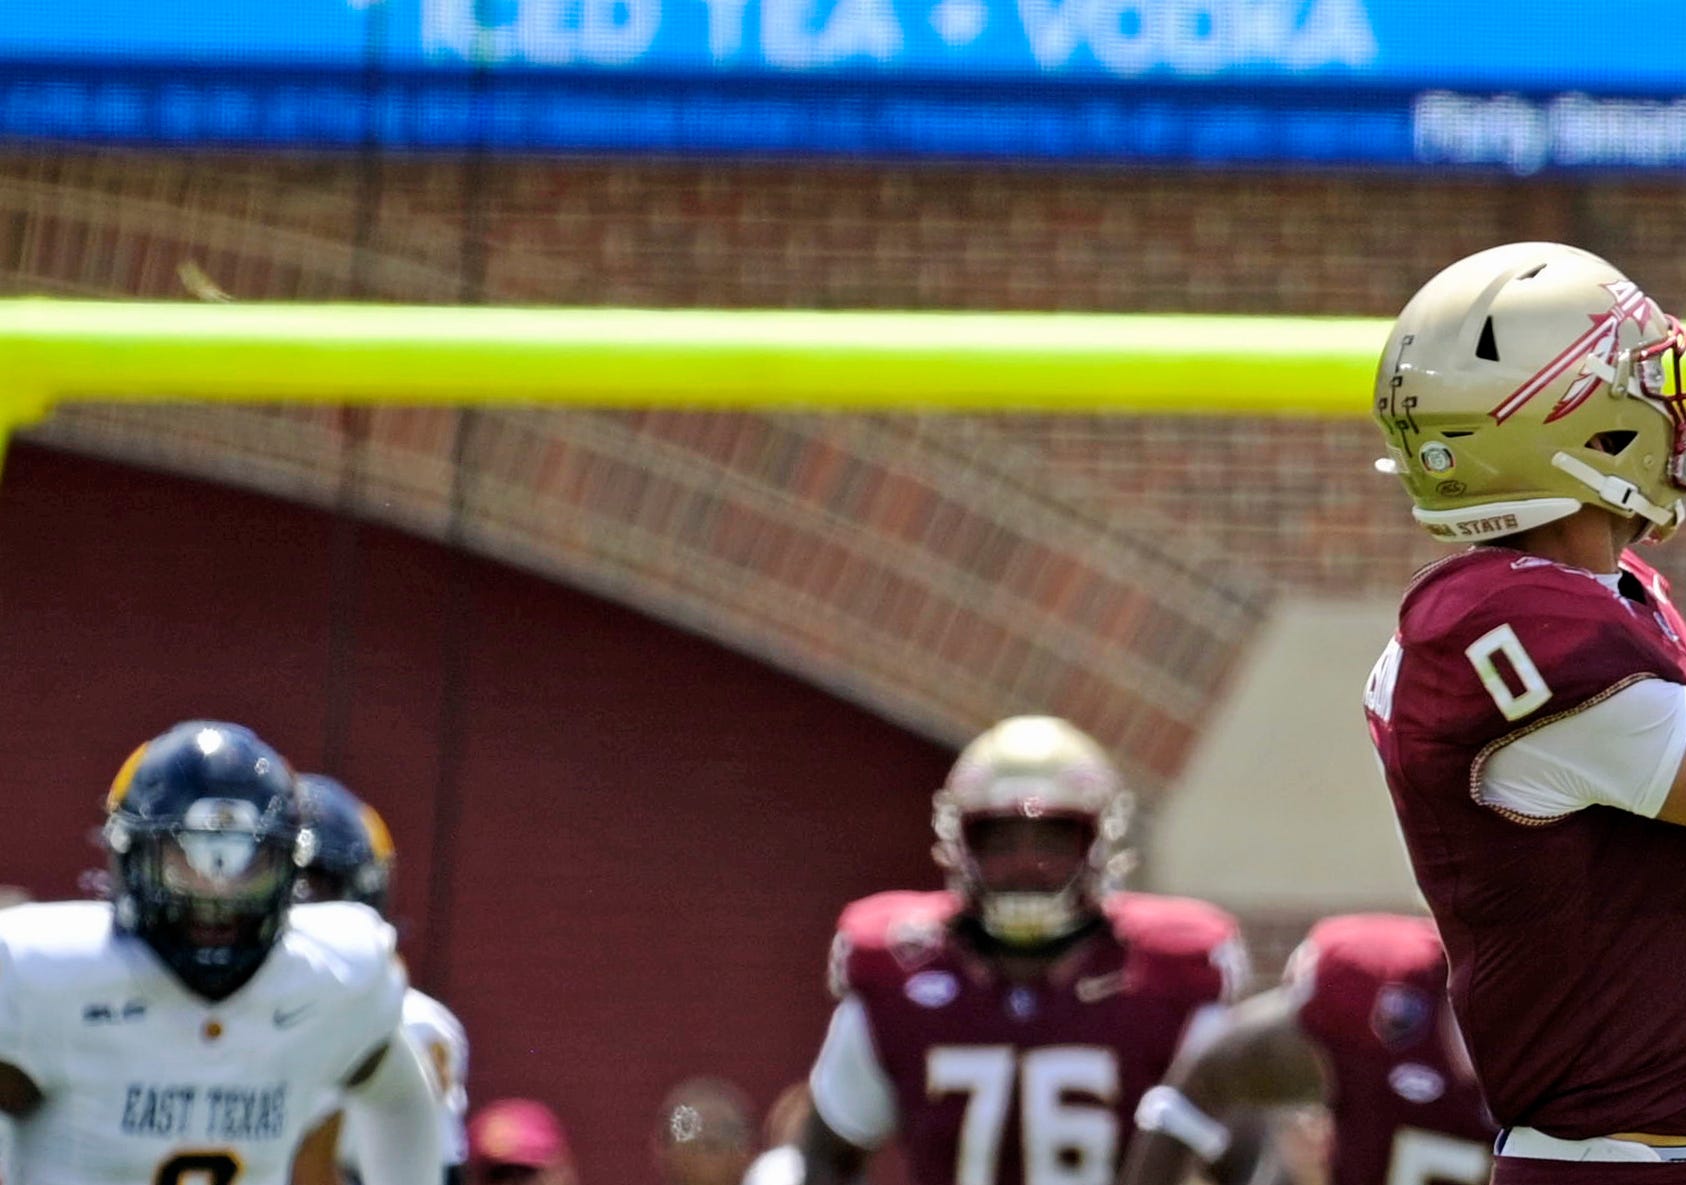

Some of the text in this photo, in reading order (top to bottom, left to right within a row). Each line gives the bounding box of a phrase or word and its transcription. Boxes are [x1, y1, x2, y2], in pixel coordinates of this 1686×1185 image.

[420, 0, 1380, 77] ICED TEA VODKA
[1456, 513, 1519, 536] STATE
[1464, 622, 1553, 722] 0
[121, 1080, 288, 1141] EAST TEXAS
